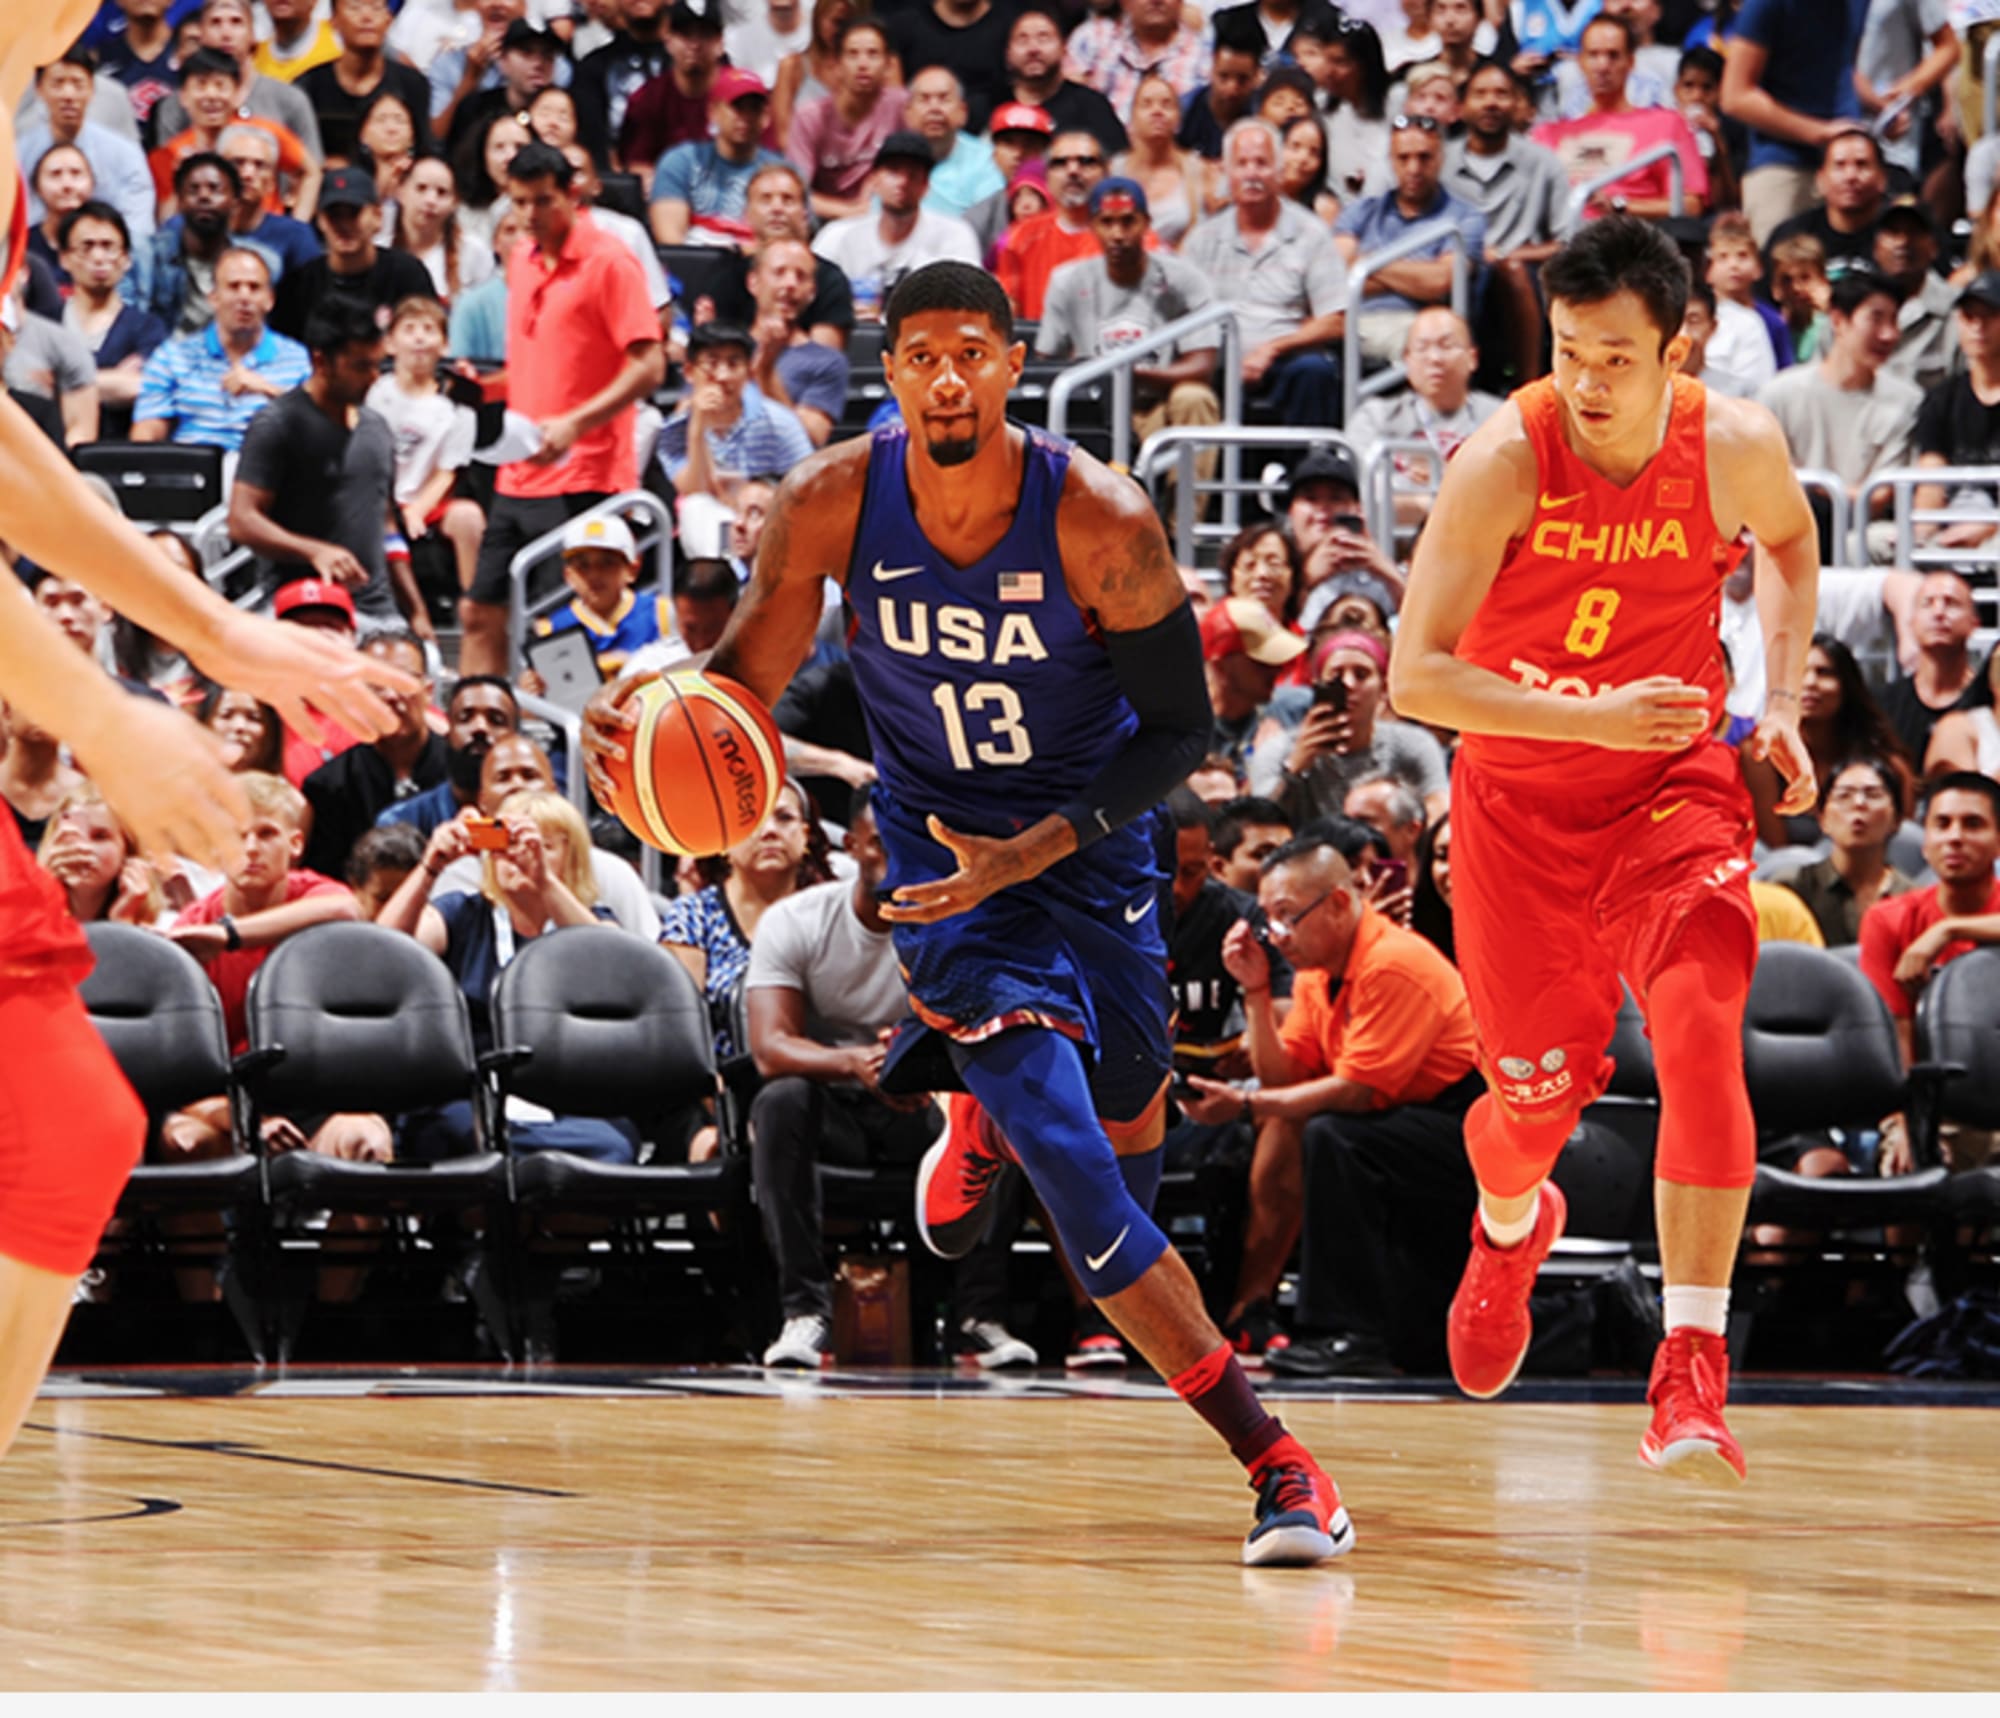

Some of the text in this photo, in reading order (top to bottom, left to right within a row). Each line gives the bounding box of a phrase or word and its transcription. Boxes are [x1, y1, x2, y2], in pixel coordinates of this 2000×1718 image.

[1532, 519, 1689, 564] CHINA
[877, 596, 1049, 665] USA
[1564, 587, 1621, 658] 8
[932, 682, 1033, 771] 13
[712, 728, 757, 827] molten
